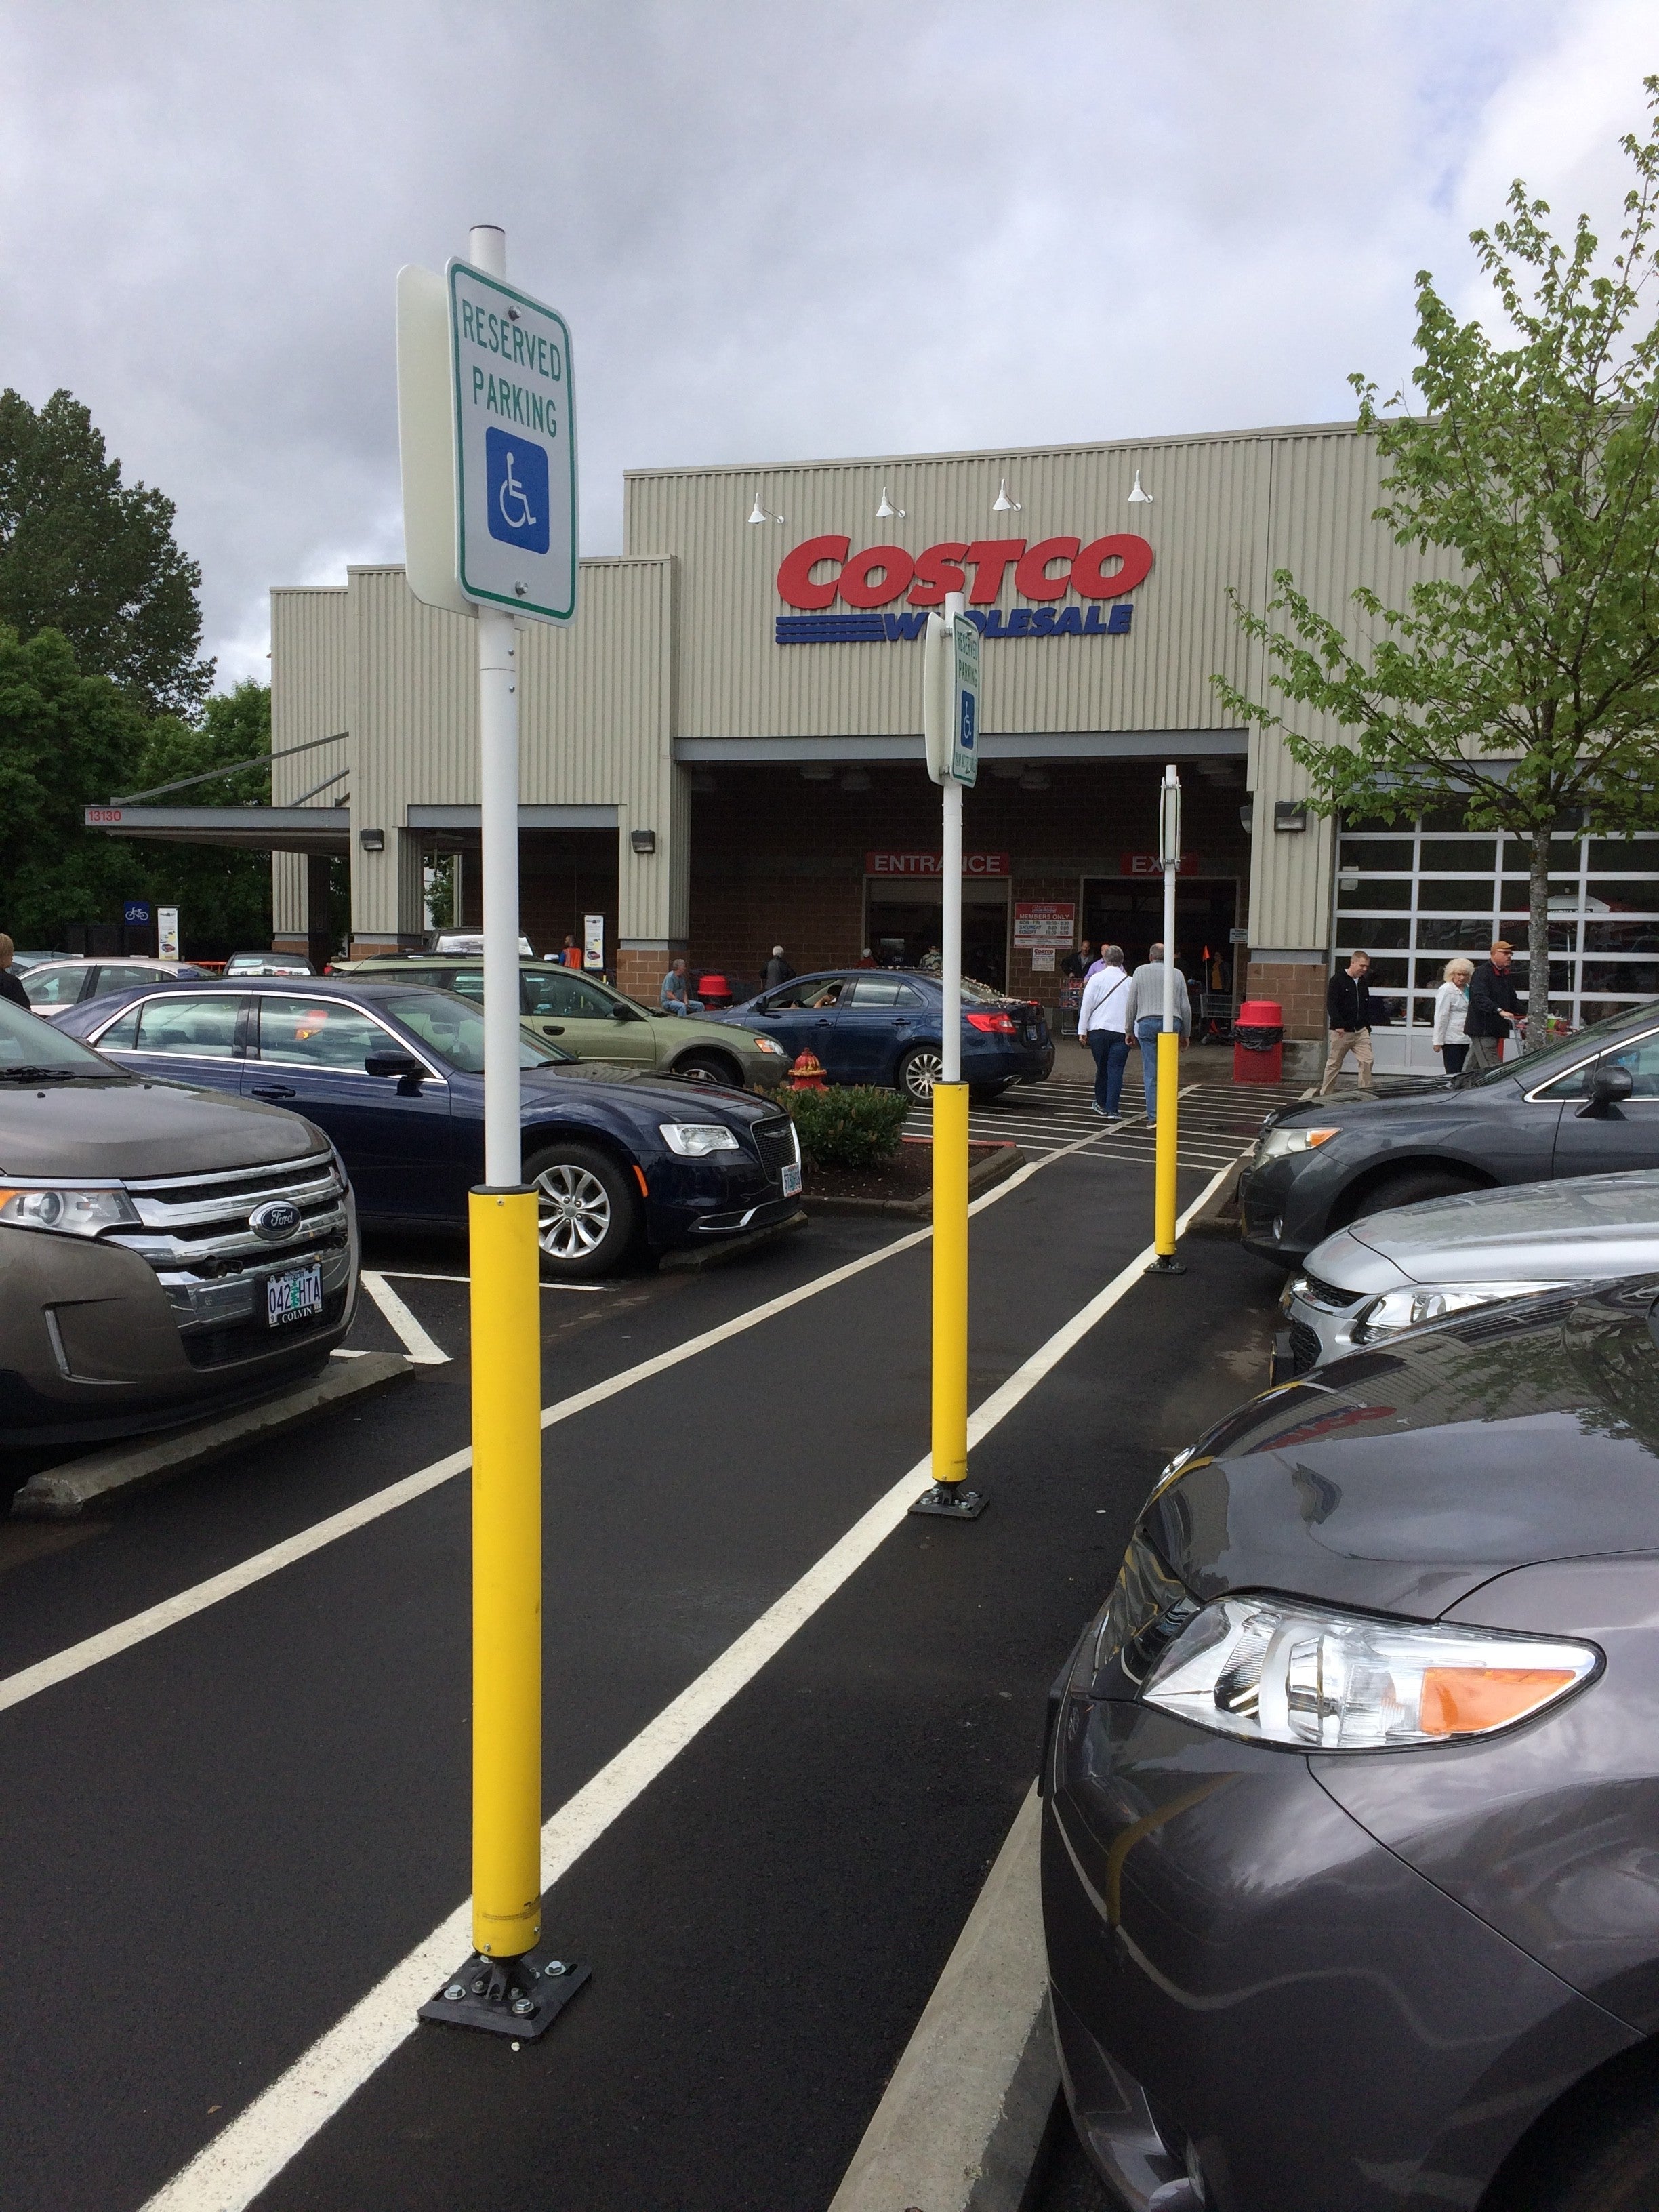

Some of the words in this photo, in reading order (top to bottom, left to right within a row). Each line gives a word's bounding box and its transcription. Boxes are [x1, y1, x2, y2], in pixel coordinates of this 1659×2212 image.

[462, 299, 562, 382] RESERVED
[472, 365, 557, 438] PARKING
[776, 533, 1153, 609] COSTCO
[958, 659, 977, 687] PARKING
[89, 811, 121, 821] 13130
[270, 1208, 294, 1227] Ford
[269, 1284, 291, 1314] 042
[298, 1275, 321, 1305] HTA
[281, 1306, 312, 1324] COLVIN
